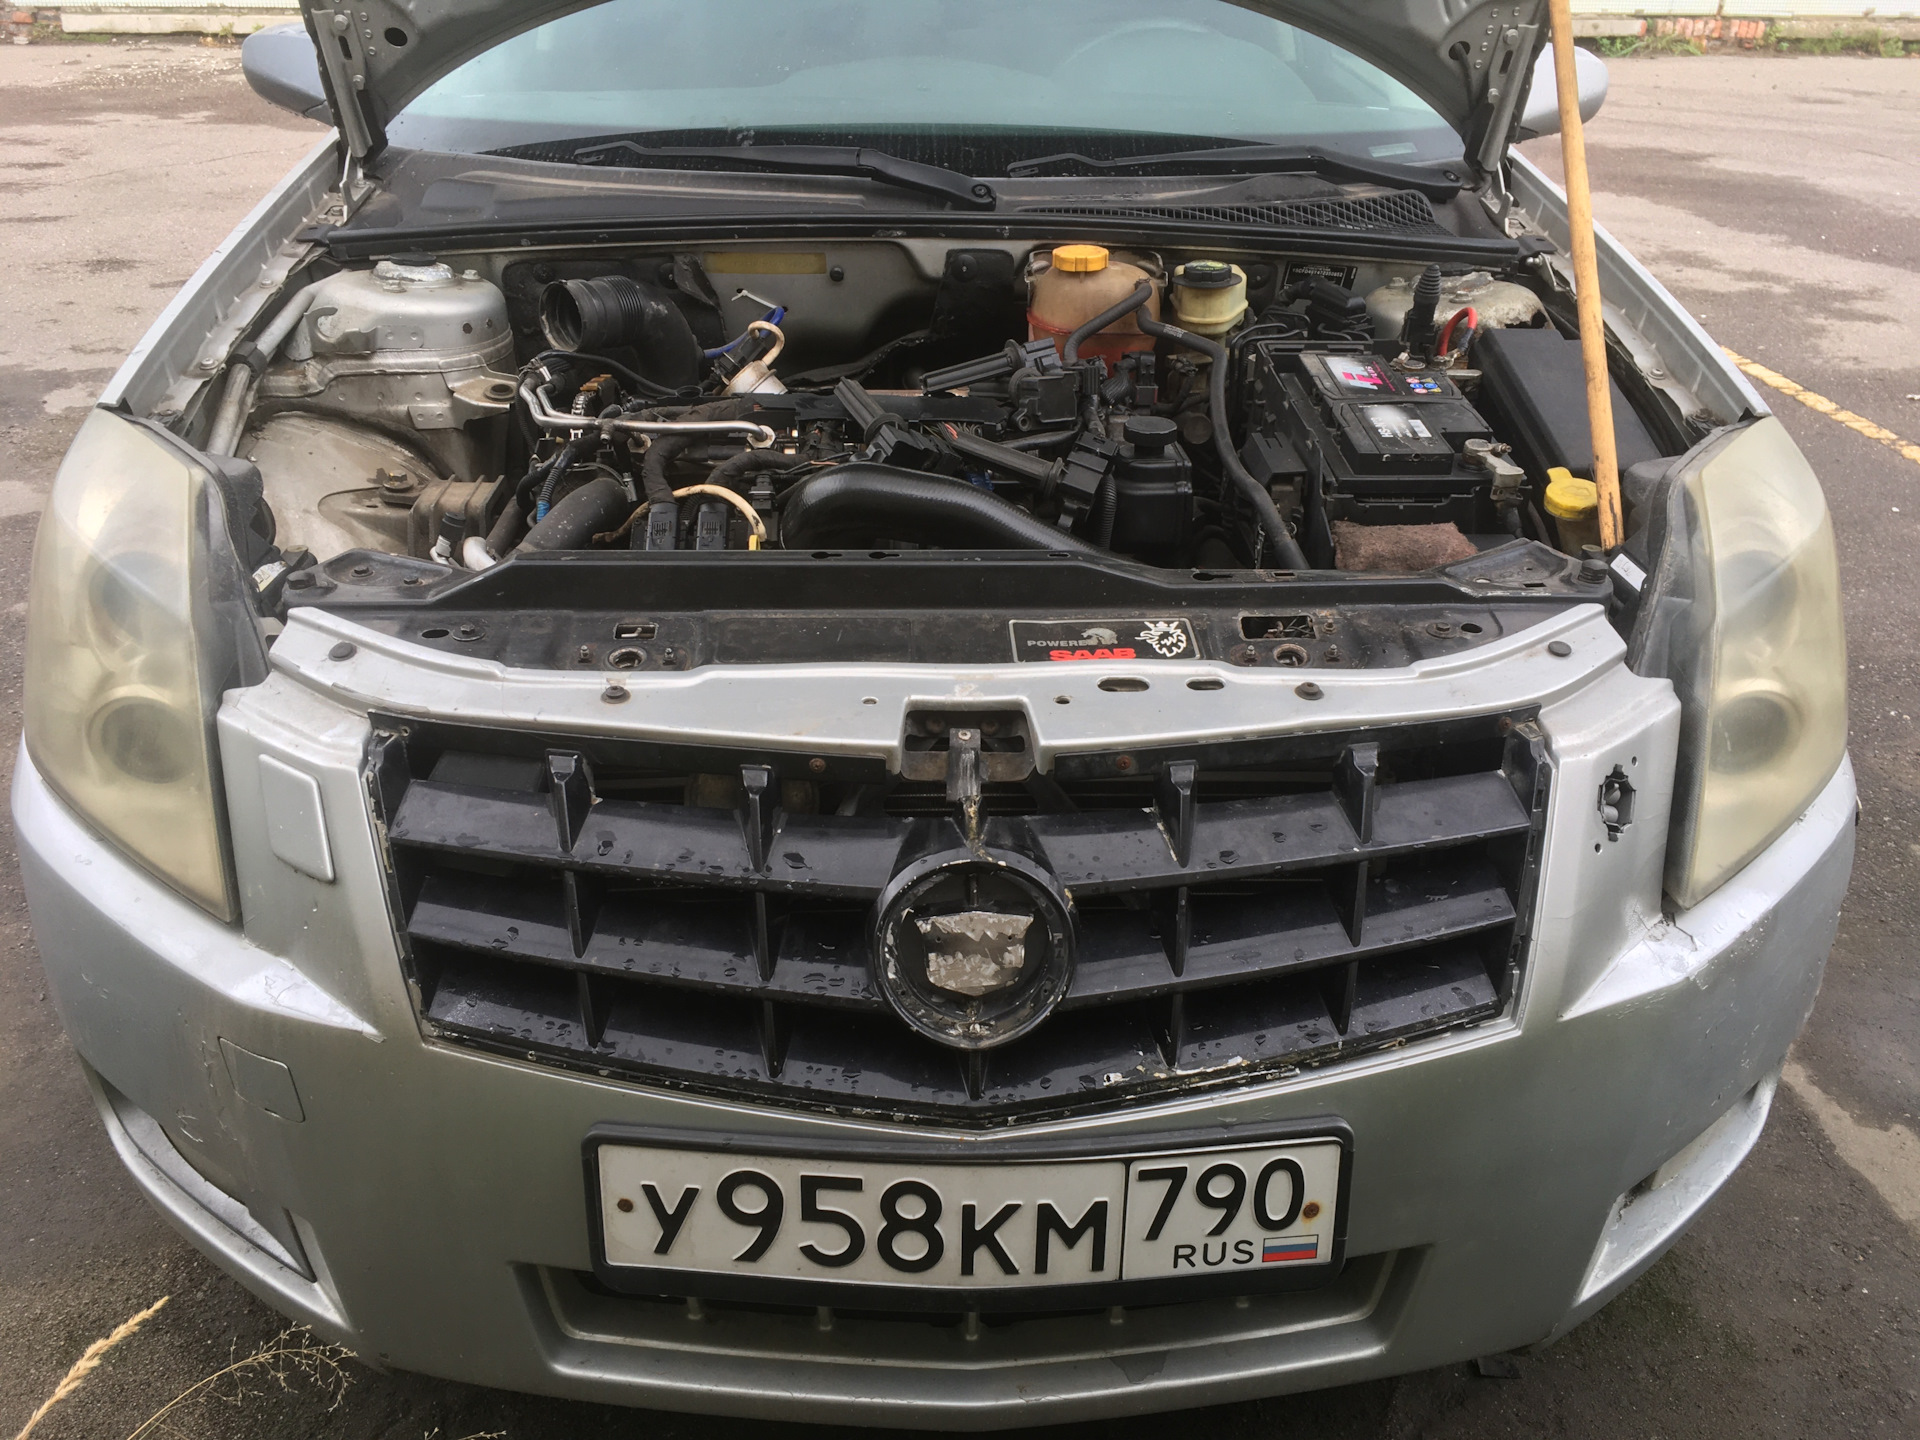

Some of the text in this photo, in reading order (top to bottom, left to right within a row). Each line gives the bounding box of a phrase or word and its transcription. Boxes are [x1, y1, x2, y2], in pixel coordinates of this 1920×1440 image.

[1049, 647, 1137, 661] SAAB
[1137, 1157, 1303, 1241] 790
[1172, 1238, 1255, 1269] RUS
